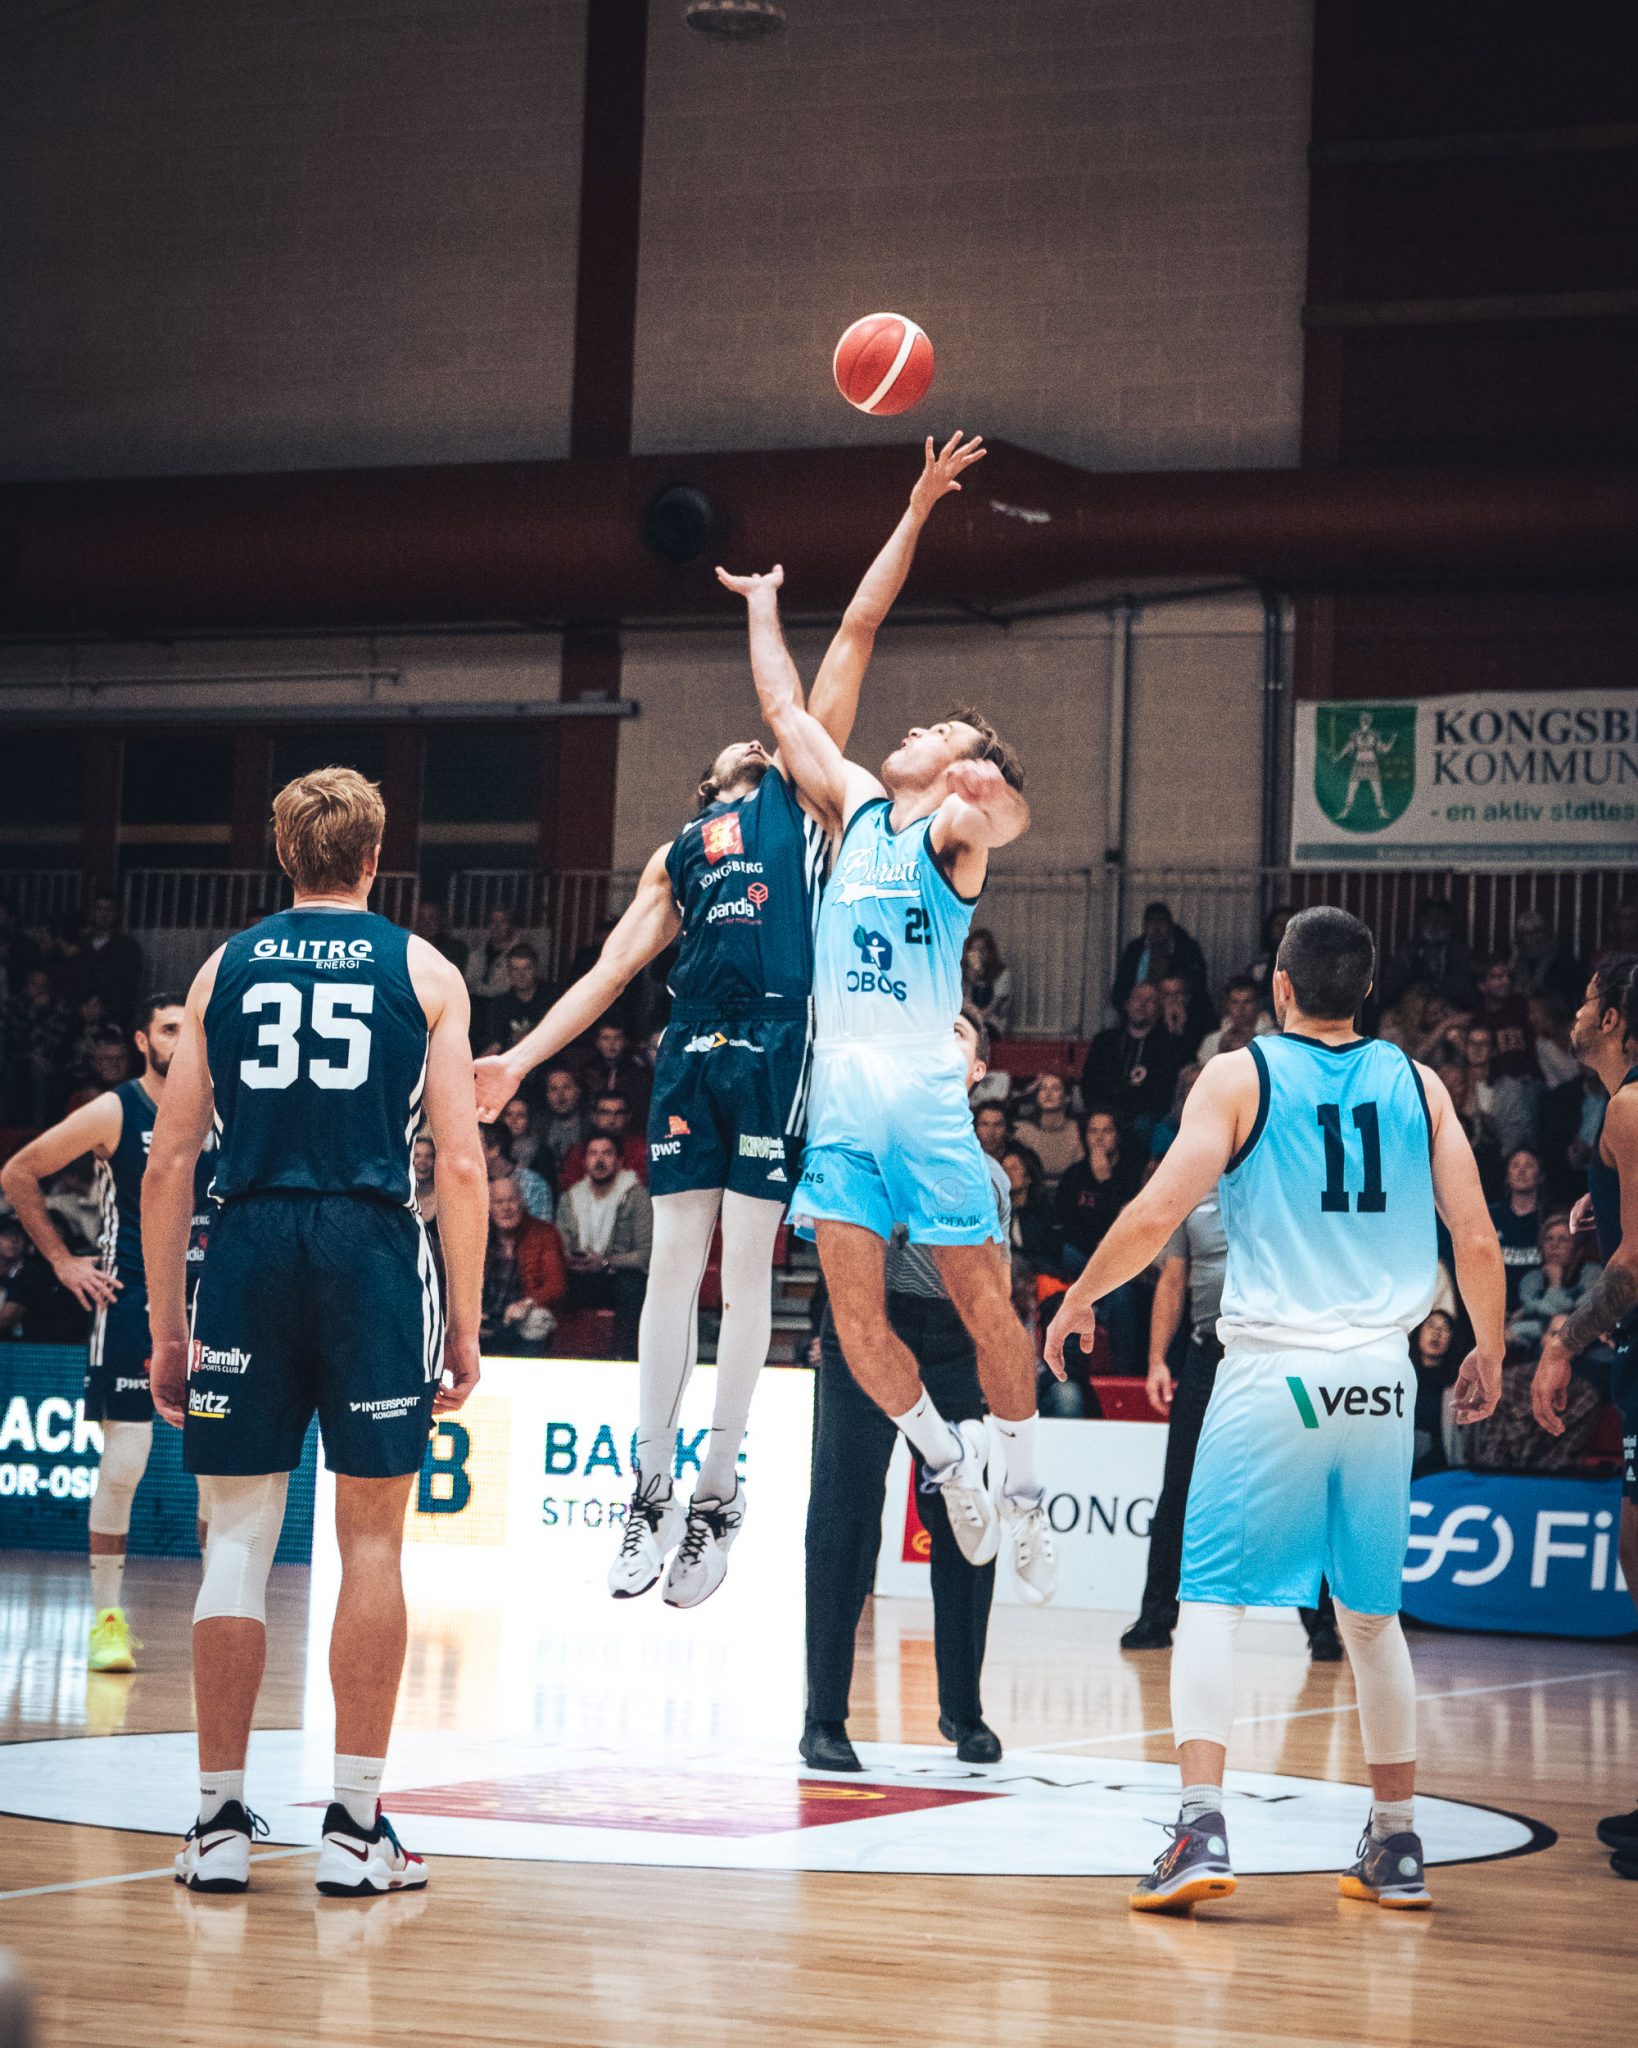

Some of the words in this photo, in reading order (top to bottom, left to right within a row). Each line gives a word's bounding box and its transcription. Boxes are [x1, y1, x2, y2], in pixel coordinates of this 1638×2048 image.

[1434, 707, 1638, 745] KONGSB
[1446, 804, 1476, 822] en
[1484, 801, 1543, 822] aktiv
[315, 960, 360, 970] ENERGI
[846, 970, 907, 1002] OBOS
[240, 982, 375, 1090] 35
[651, 1141, 681, 1161] pwc
[1316, 1101, 1387, 1213] 11
[201, 1346, 251, 1374] Family
[201, 1363, 221, 1373] SPORTS
[222, 1364, 240, 1375] CLUB
[189, 1388, 229, 1413] Hertz
[362, 1396, 421, 1413] INTERSPORT
[1318, 1381, 1405, 1418] vest
